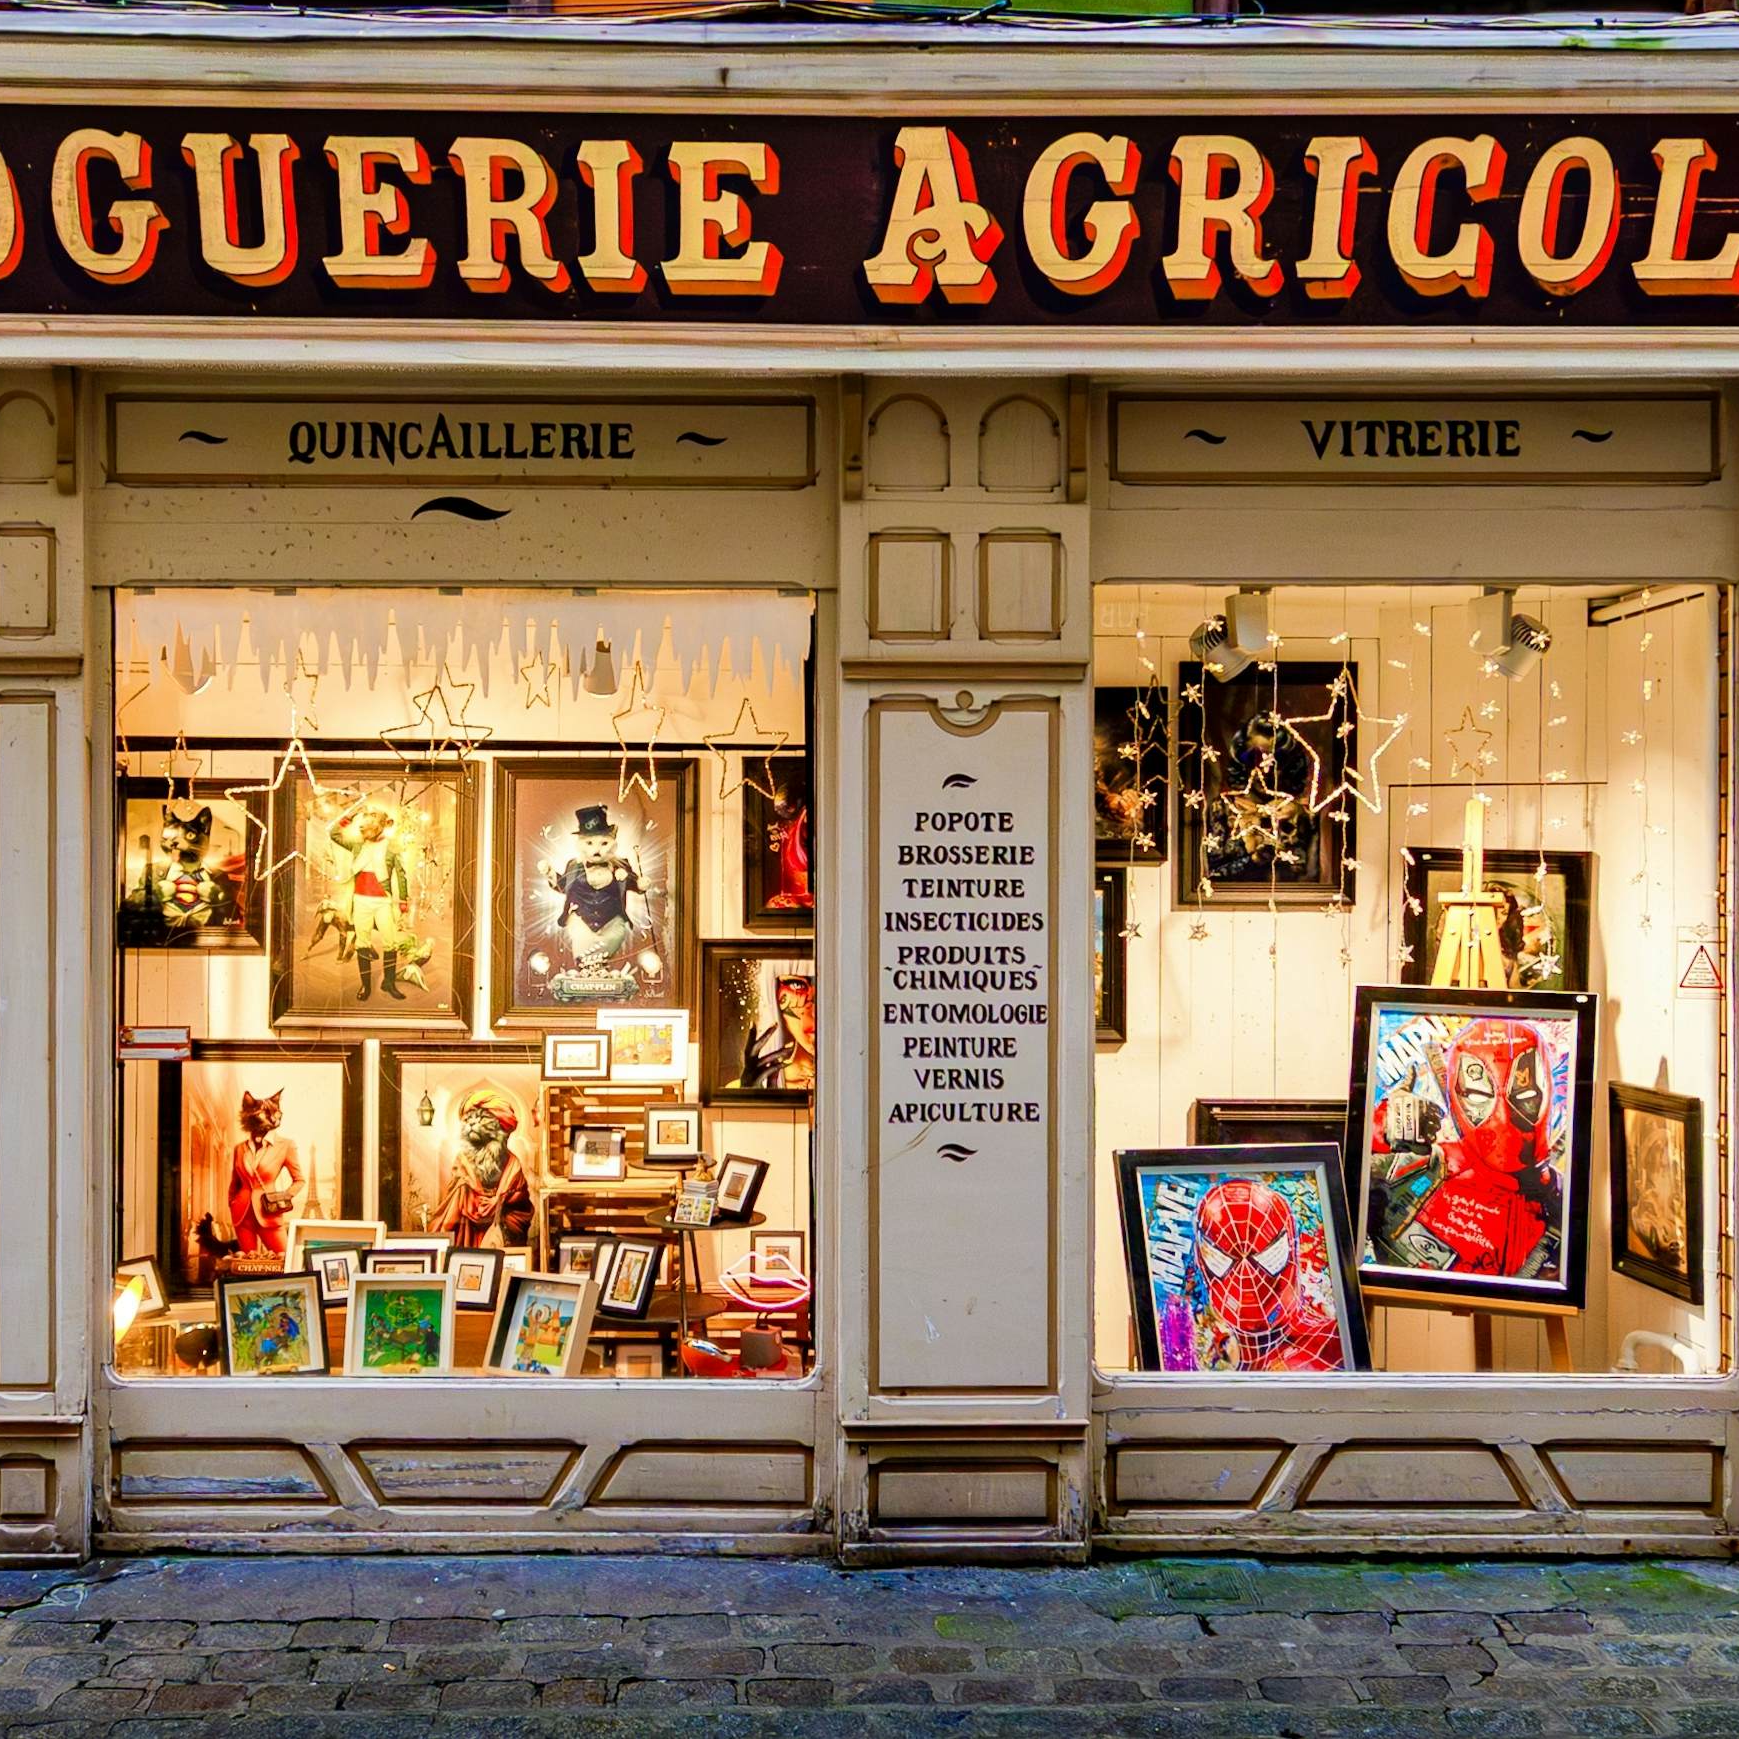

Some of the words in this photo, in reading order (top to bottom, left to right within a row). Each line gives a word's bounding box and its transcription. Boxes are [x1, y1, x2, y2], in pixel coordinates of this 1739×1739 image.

[288, 412, 637, 466] QUINCAILLERIE
[1300, 419, 1522, 460] VITRERIE
[914, 812, 1014, 832] POPOTE
[897, 845, 1036, 866] BROSSERIE
[902, 878, 1025, 899] TEINTURE
[884, 911, 1044, 932] INSECTICIDES
[897, 945, 1026, 966] PRODUITS
[893, 969, 1038, 992] CHIMIQUES
[883, 1003, 1048, 1025] ENTOMOLOGIE
[903, 1037, 1018, 1058] PEINTURE
[914, 1068, 1004, 1090] VERNIS
[888, 1102, 1040, 1123] APICULTURE
